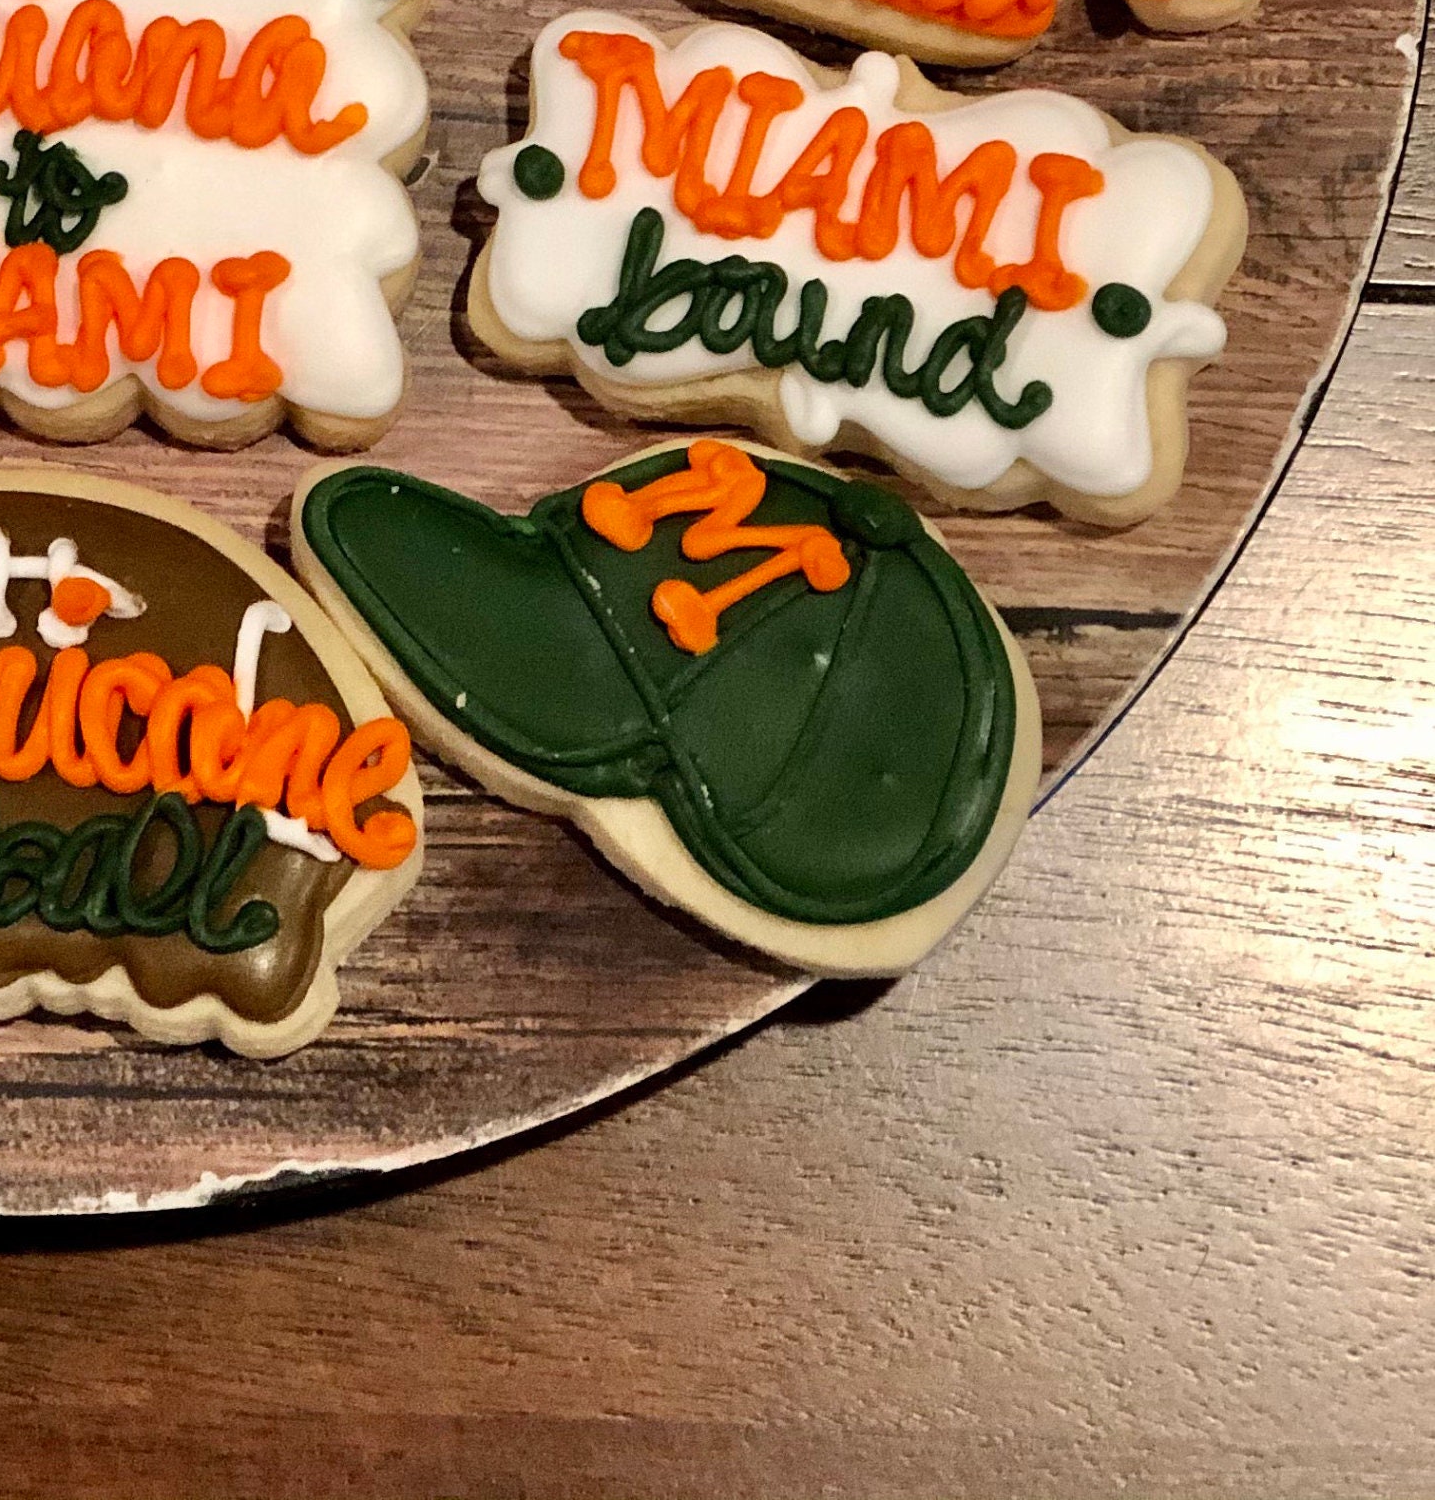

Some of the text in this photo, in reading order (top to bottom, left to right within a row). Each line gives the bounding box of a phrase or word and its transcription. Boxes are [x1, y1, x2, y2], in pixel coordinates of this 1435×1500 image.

[558, 30, 1106, 311] MIAMI
[576, 206, 1052, 429] bound
[582, 440, 851, 655] M
